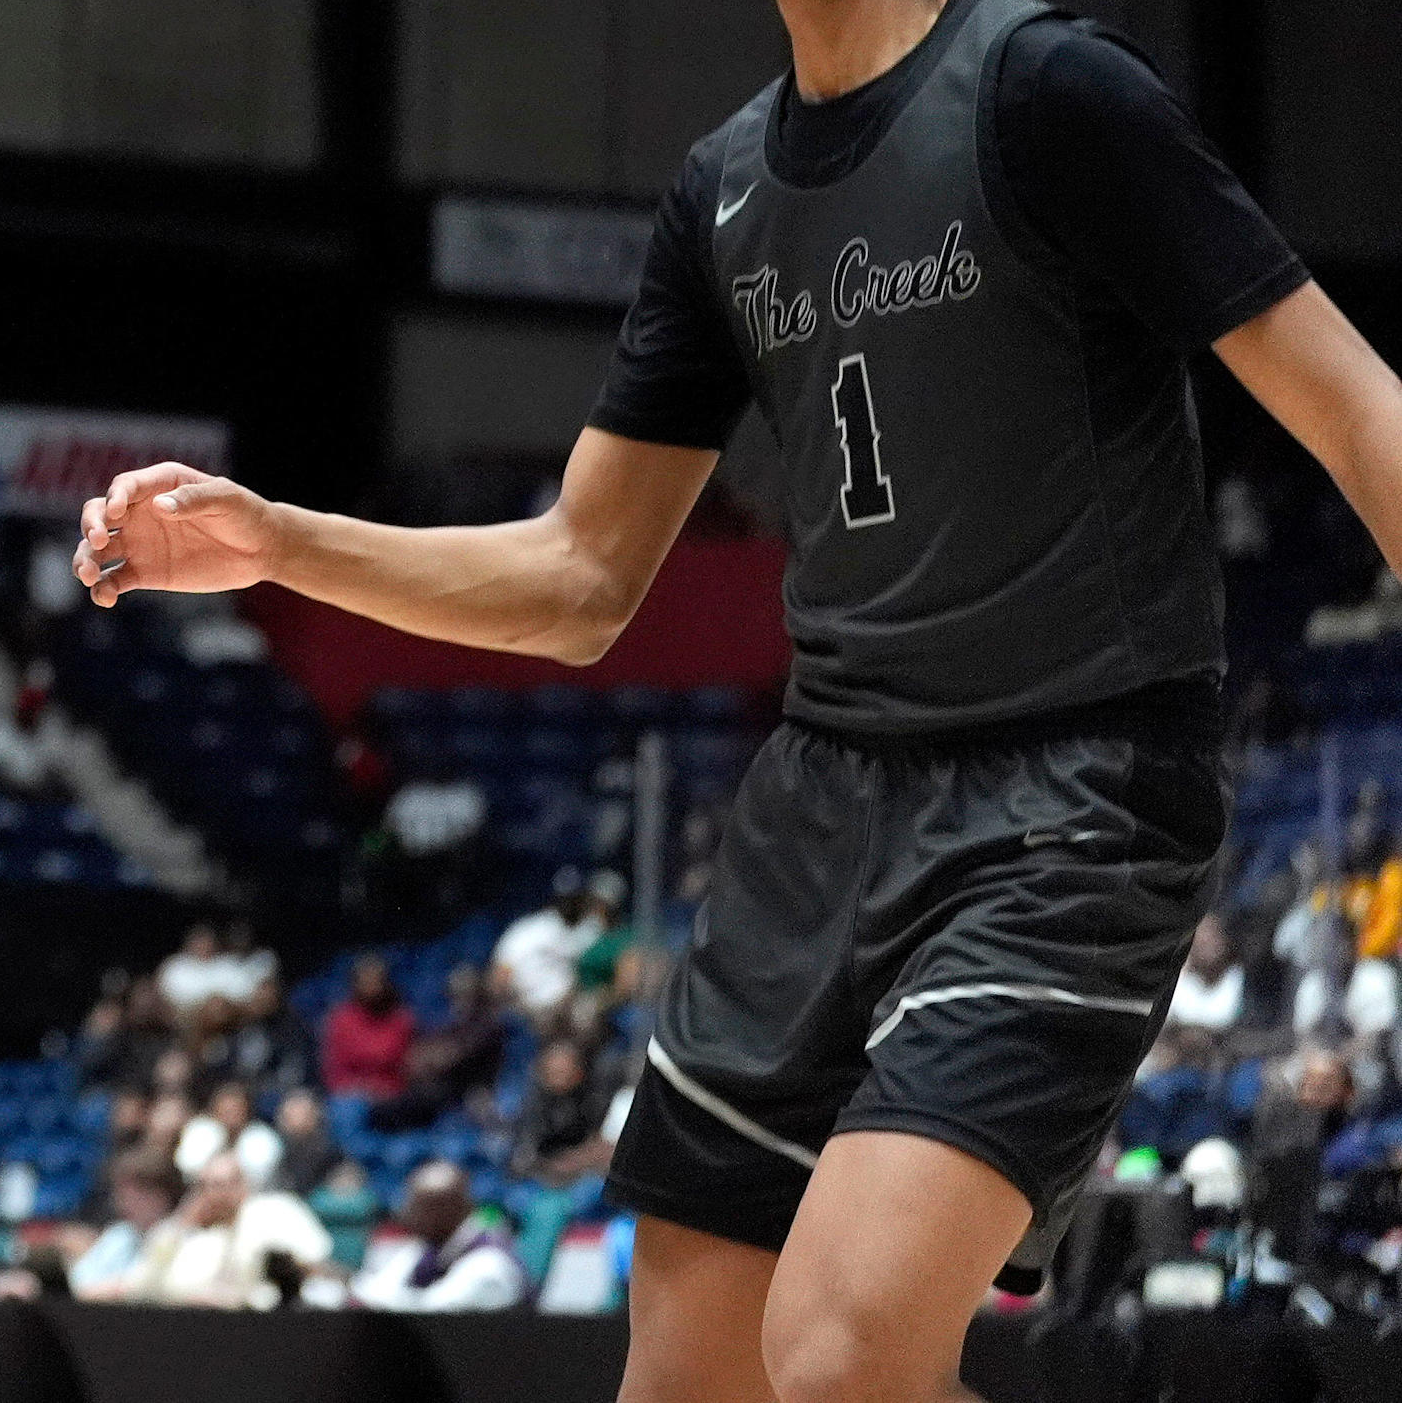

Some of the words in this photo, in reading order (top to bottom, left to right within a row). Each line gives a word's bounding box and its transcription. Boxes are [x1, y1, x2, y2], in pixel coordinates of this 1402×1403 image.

[732, 263, 818, 360] The
[831, 218, 982, 329] Creek
[830, 351, 896, 530] 1
